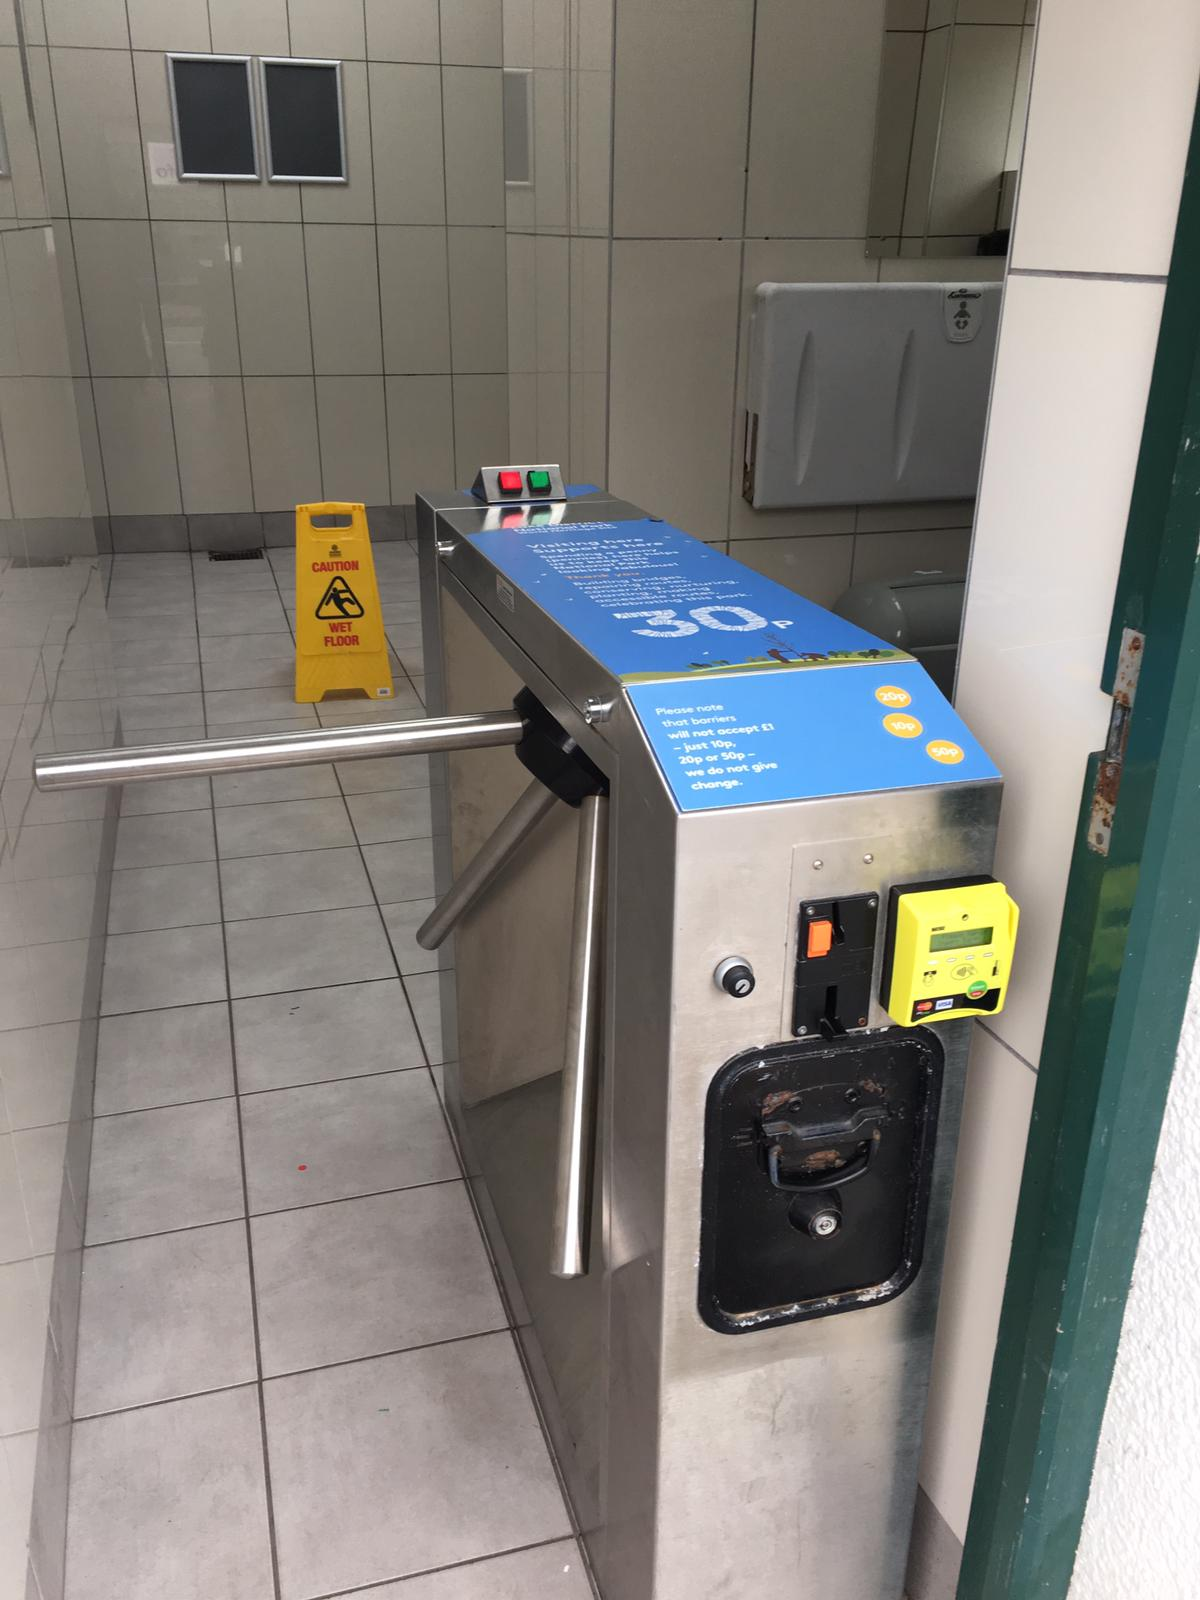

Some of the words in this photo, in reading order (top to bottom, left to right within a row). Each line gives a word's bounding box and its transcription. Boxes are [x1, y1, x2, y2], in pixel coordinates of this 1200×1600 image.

[526, 541, 600, 549] Visiting
[532, 545, 619, 554] Supports
[312, 560, 359, 573] CAUTION
[573, 578, 629, 587] Building
[578, 582, 642, 590] repairing
[584, 586, 665, 595] conserving,
[670, 580, 740, 588] nurturing,
[589, 592, 653, 600] planting,
[595, 595, 668, 603] accessible
[600, 599, 683, 608] celebrating
[329, 622, 352, 633] WET
[324, 635, 360, 648] FLOOR
[879, 691, 907, 702] 20p
[655, 706, 695, 716] Please
[696, 704, 724, 713] note
[662, 718, 689, 728] that
[691, 715, 737, 726] barriers
[667, 730, 690, 740] will
[692, 729, 715, 737] not
[717, 724, 760, 735] accept
[761, 723, 775, 732] £1
[683, 742, 709, 753] just
[710, 740, 737, 749] 10p,
[678, 755, 704, 765] 20p
[720, 751, 746, 761] 50p
[685, 769, 705, 777] we
[707, 767, 725, 775] do
[726, 764, 750, 773] not
[751, 762, 779, 773] give
[691, 779, 744, 791] change.
